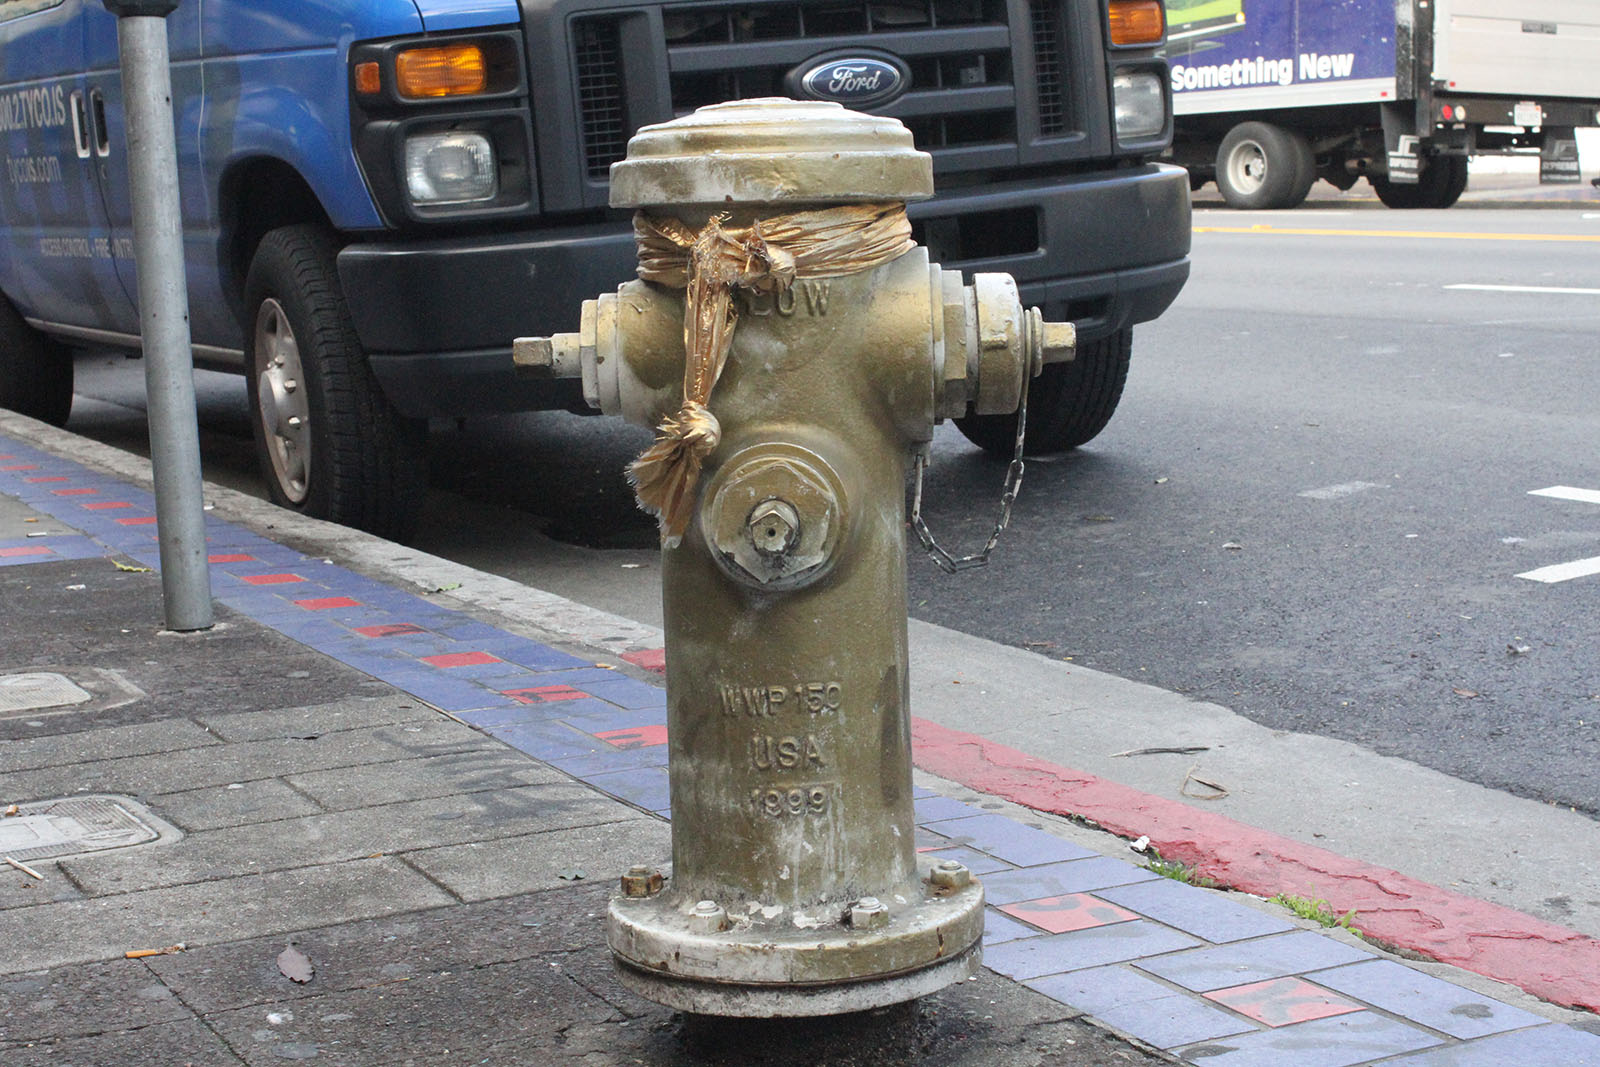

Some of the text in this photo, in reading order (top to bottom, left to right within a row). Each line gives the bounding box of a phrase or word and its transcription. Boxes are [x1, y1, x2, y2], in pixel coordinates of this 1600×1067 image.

[828, 66, 881, 93] Ford
[1171, 53, 1354, 91] Something New
[720, 681, 842, 717] WWP 150
[752, 735, 826, 769] USA
